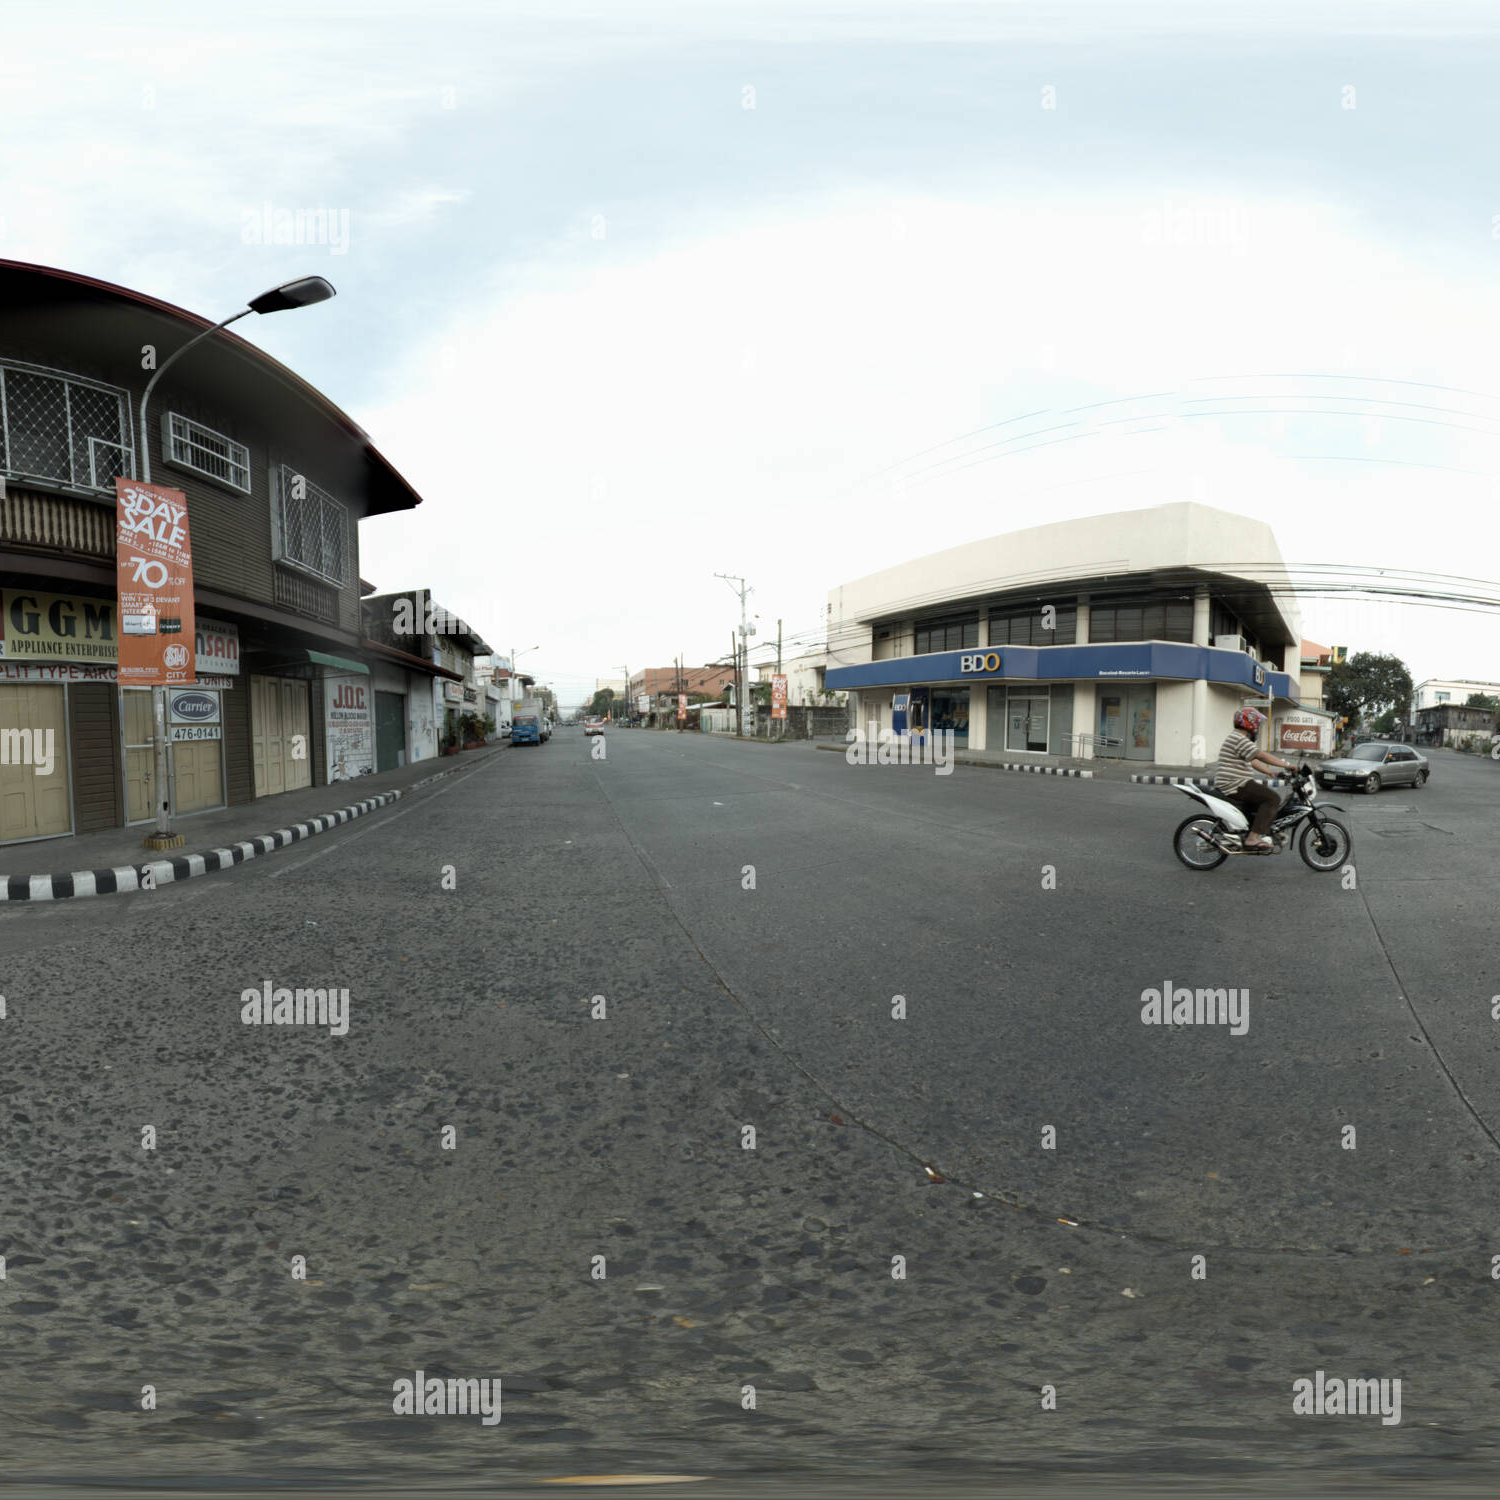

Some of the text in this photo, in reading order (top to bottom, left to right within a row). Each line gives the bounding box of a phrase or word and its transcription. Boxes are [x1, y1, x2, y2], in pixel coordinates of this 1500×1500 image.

[119, 507, 187, 550] SALE
[130, 556, 168, 589] 70
[10, 596, 113, 641] GGM
[11, 640, 63, 656] APPLIANCE
[960, 652, 1001, 673] BDO
[35, 665, 78, 679] TYPE
[166, 672, 187, 680] CITY
[204, 677, 232, 688] UNITS
[178, 701, 213, 713] Carrier
[894, 703, 907, 712] BDO
[174, 727, 219, 741] 476-0141
